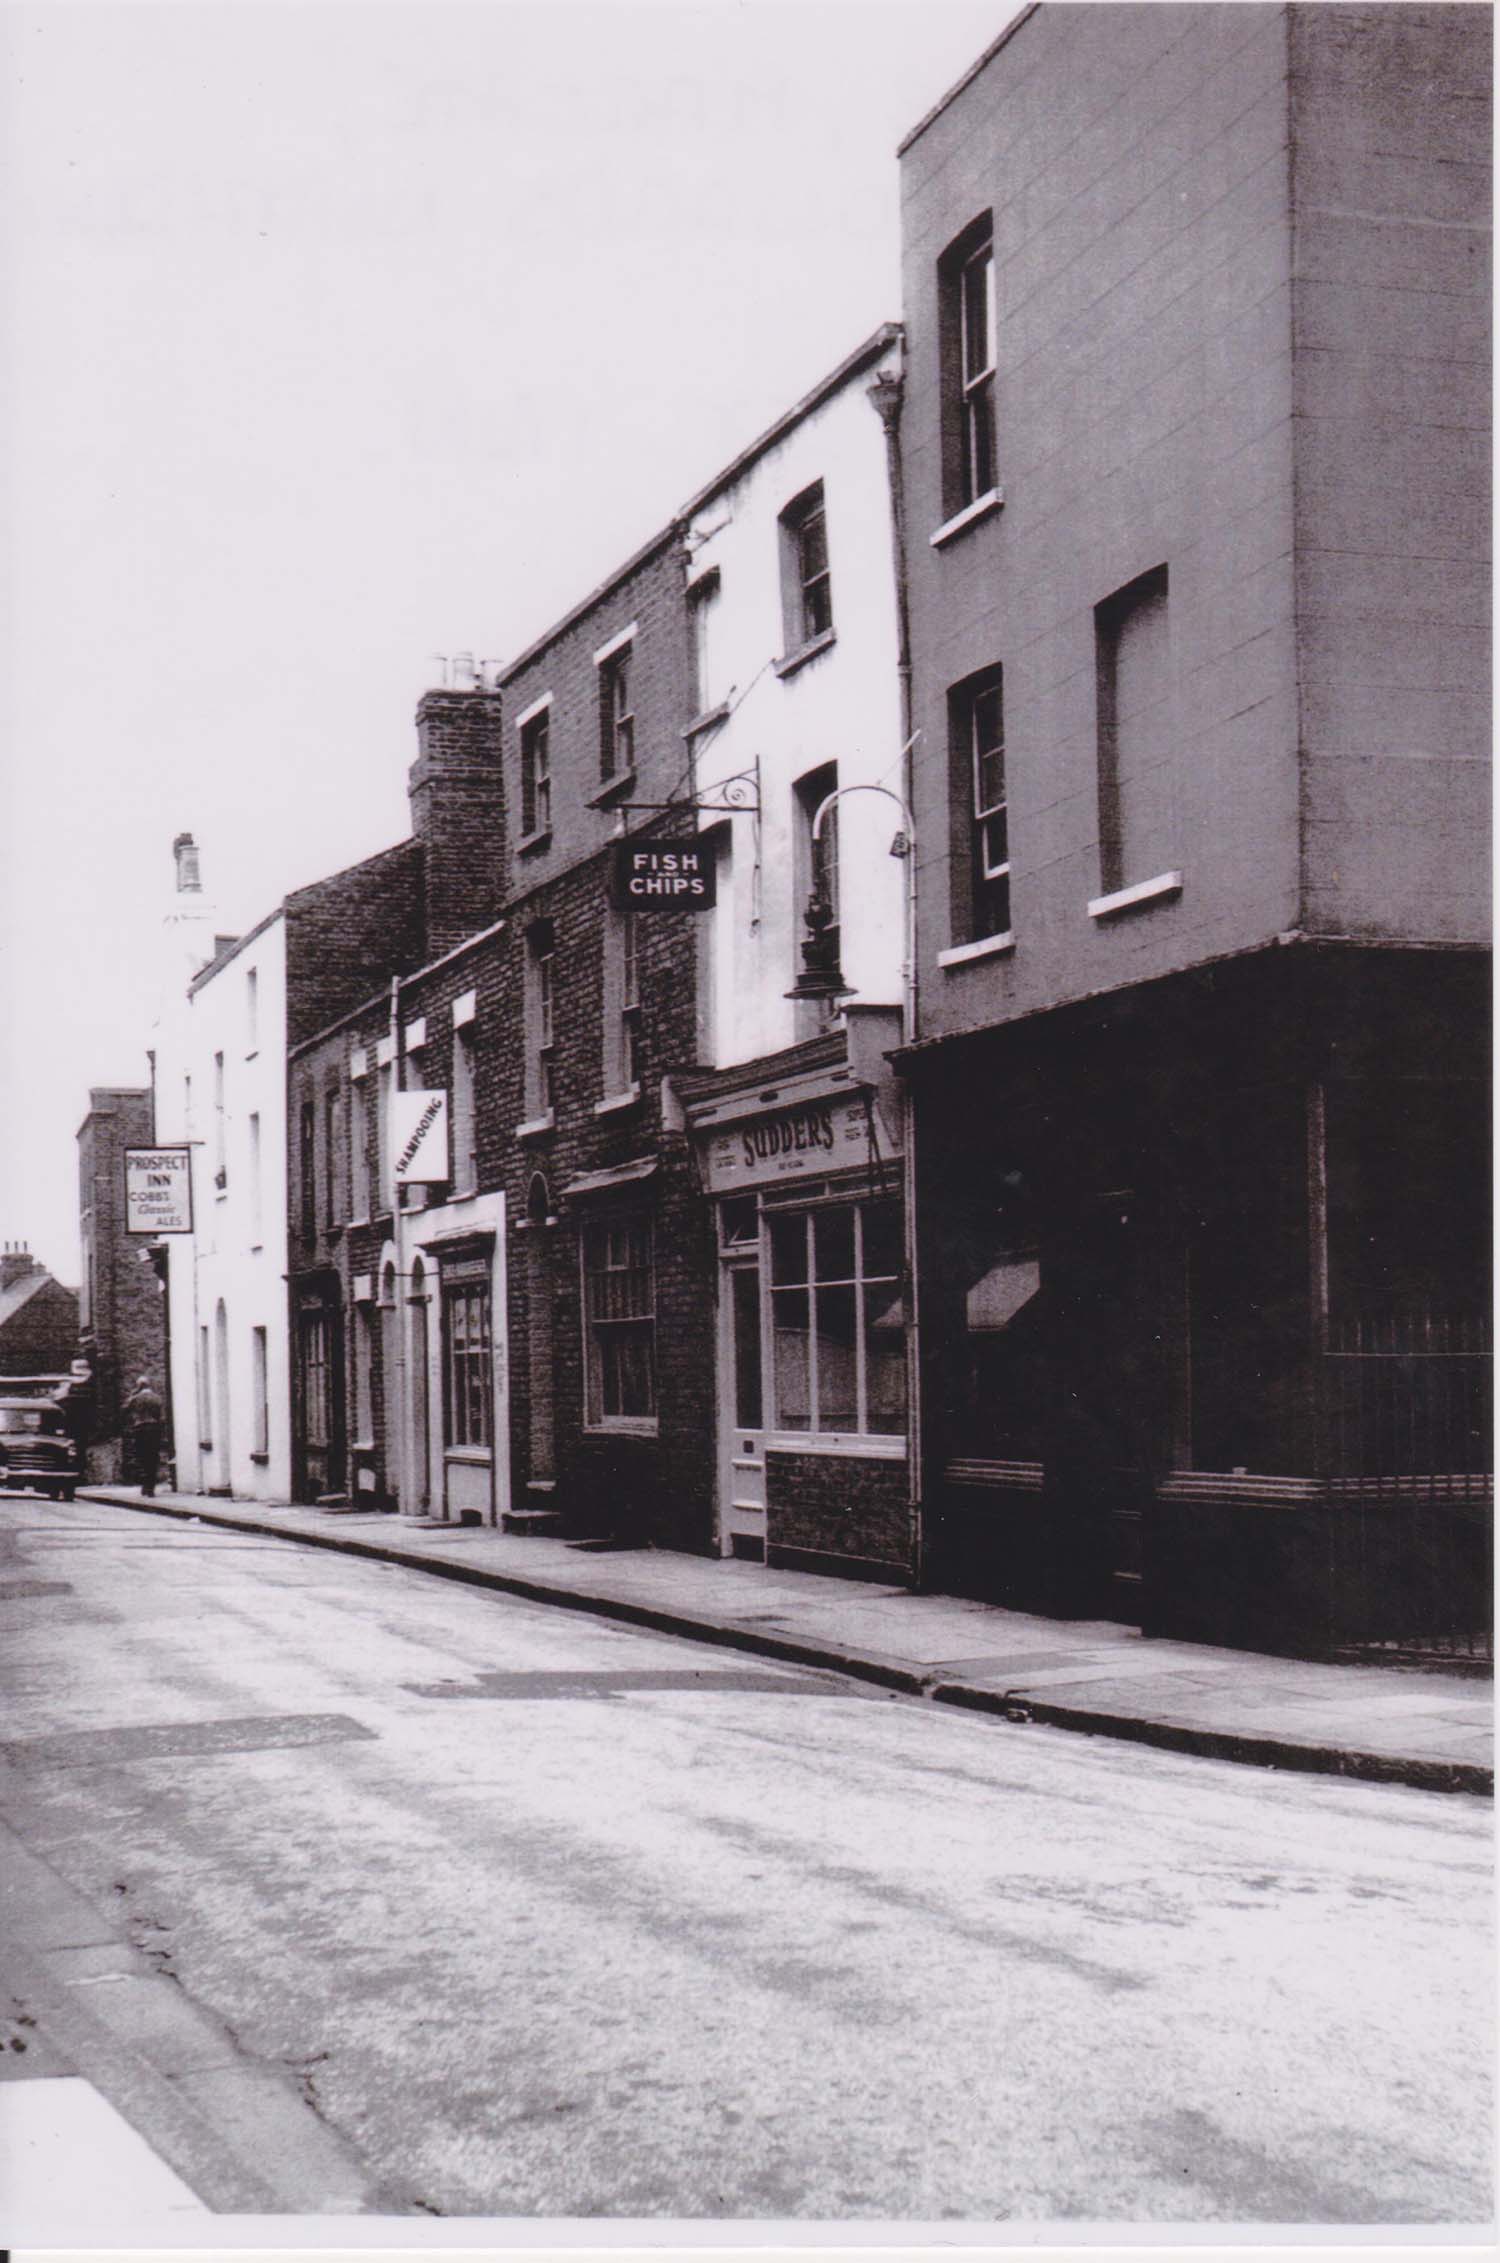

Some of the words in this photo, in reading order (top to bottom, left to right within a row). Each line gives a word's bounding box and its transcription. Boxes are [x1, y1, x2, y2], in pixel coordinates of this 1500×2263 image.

[633, 853, 698, 870] FISH
[629, 877, 705, 895] CHIPS
[395, 1097, 442, 1175] SHAMPOOING
[742, 1109, 834, 1168] SUDDERS
[127, 1155, 187, 1170] PROSPECT
[147, 1174, 171, 1187] INN
[155, 1216, 182, 1226] ALES
